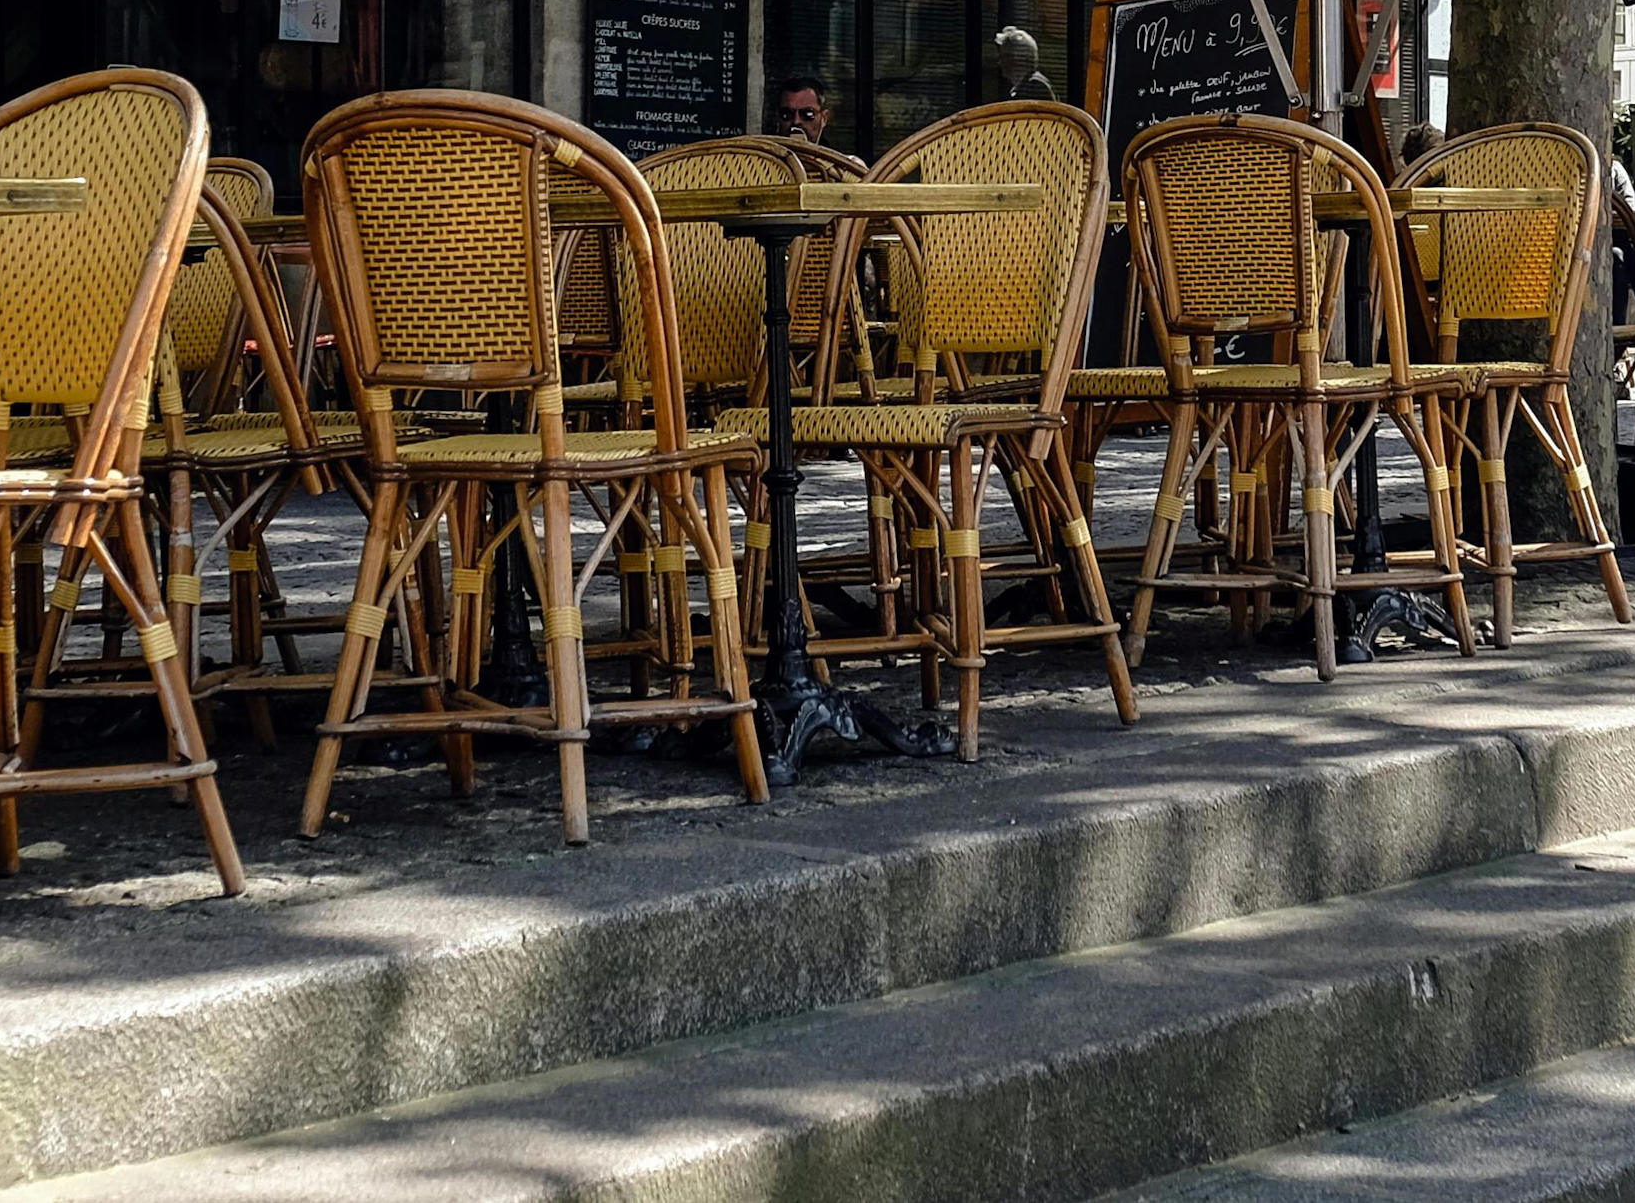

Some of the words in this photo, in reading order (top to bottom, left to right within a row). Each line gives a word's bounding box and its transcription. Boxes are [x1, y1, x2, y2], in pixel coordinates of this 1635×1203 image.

[1136, 16, 1196, 71] MENU
[1205, 32, 1217, 48] à
[1225, 12, 1289, 48] 9,9€
[635, 110, 674, 124] FROMAGE
[674, 112, 700, 125] BLANC
[627, 139, 657, 152] GLACES
